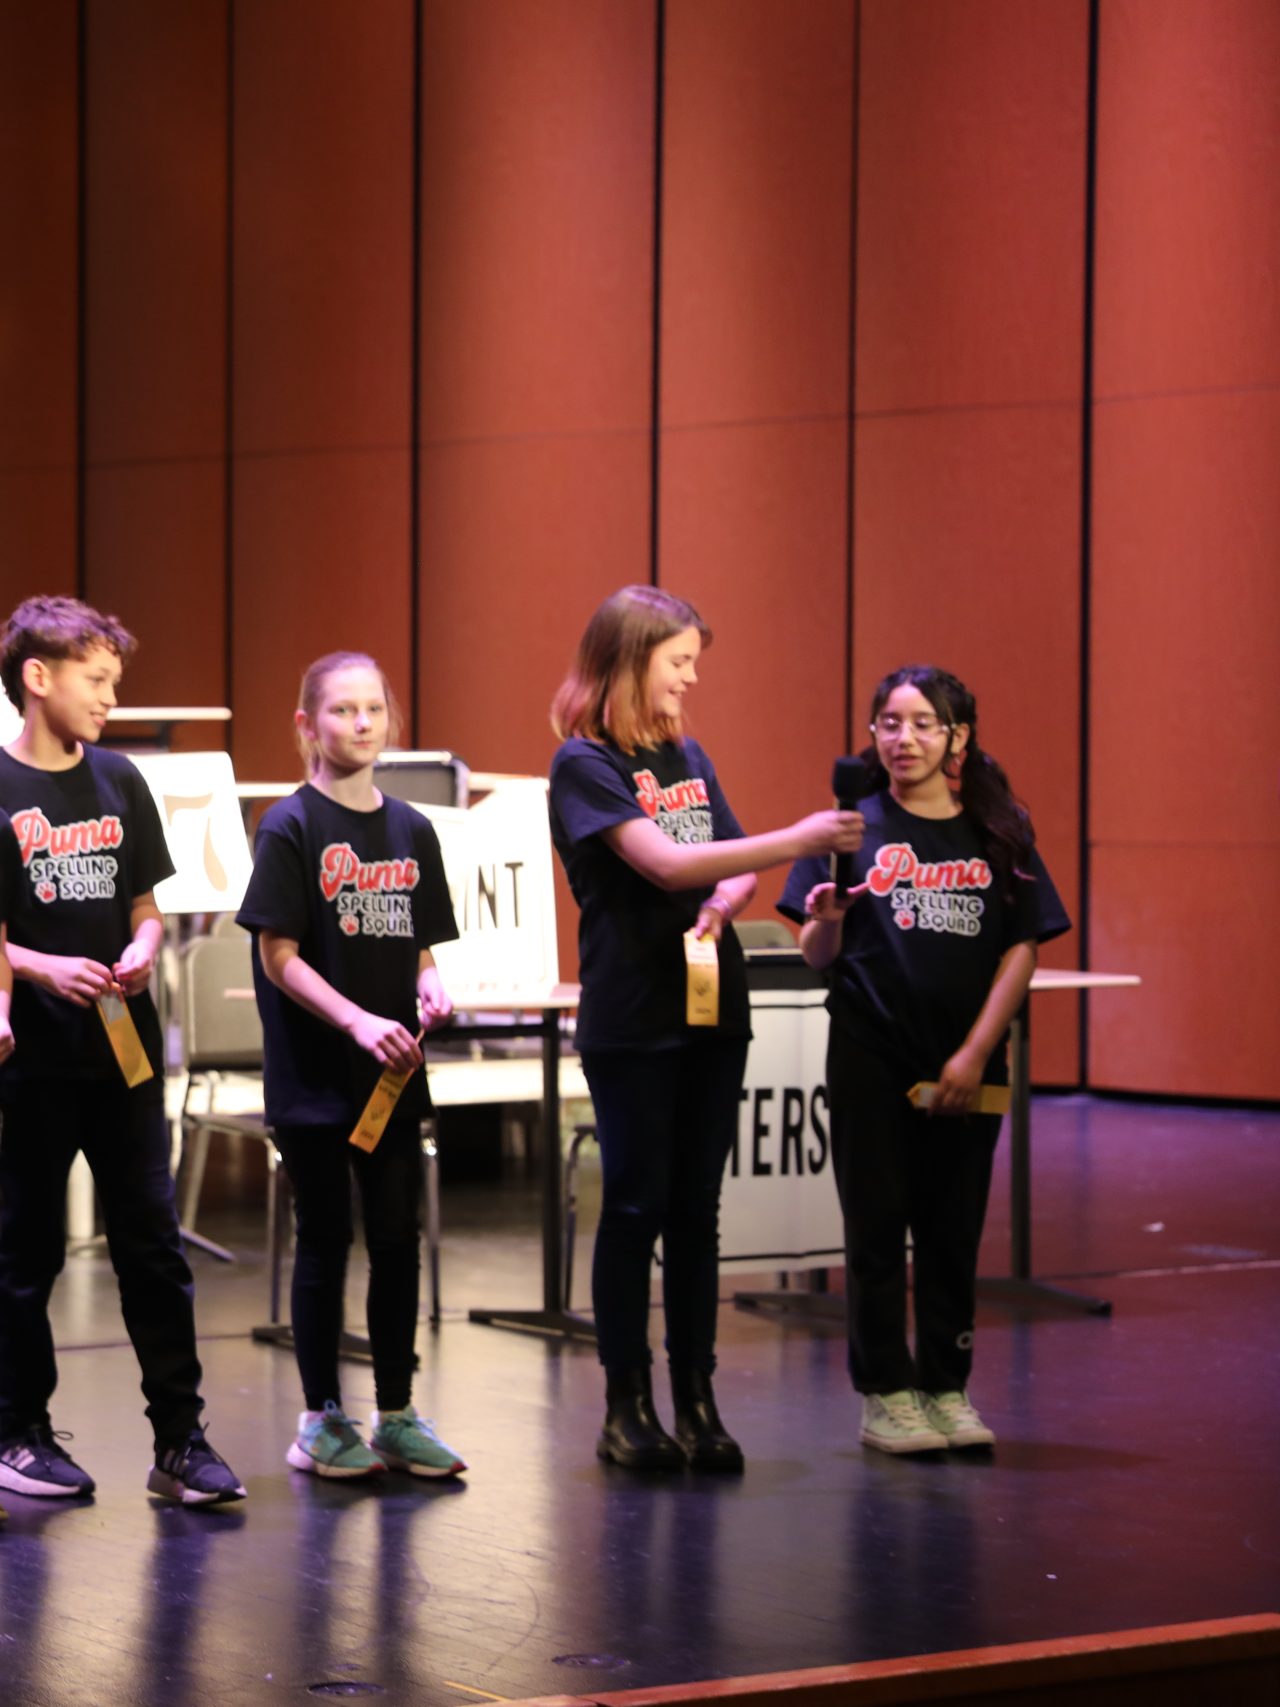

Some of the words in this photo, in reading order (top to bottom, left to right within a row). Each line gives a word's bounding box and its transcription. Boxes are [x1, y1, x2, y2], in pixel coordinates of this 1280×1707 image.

[11, 806, 123, 868] Puma
[30, 855, 118, 882] SPELLING
[320, 842, 420, 902] Puma
[865, 842, 993, 897] Puma
[59, 879, 116, 901] SQUAD
[337, 891, 413, 915] SPELLIN
[891, 887, 985, 919] SPELLING
[362, 914, 414, 938] SQUA
[917, 910, 980, 937] SQUAD
